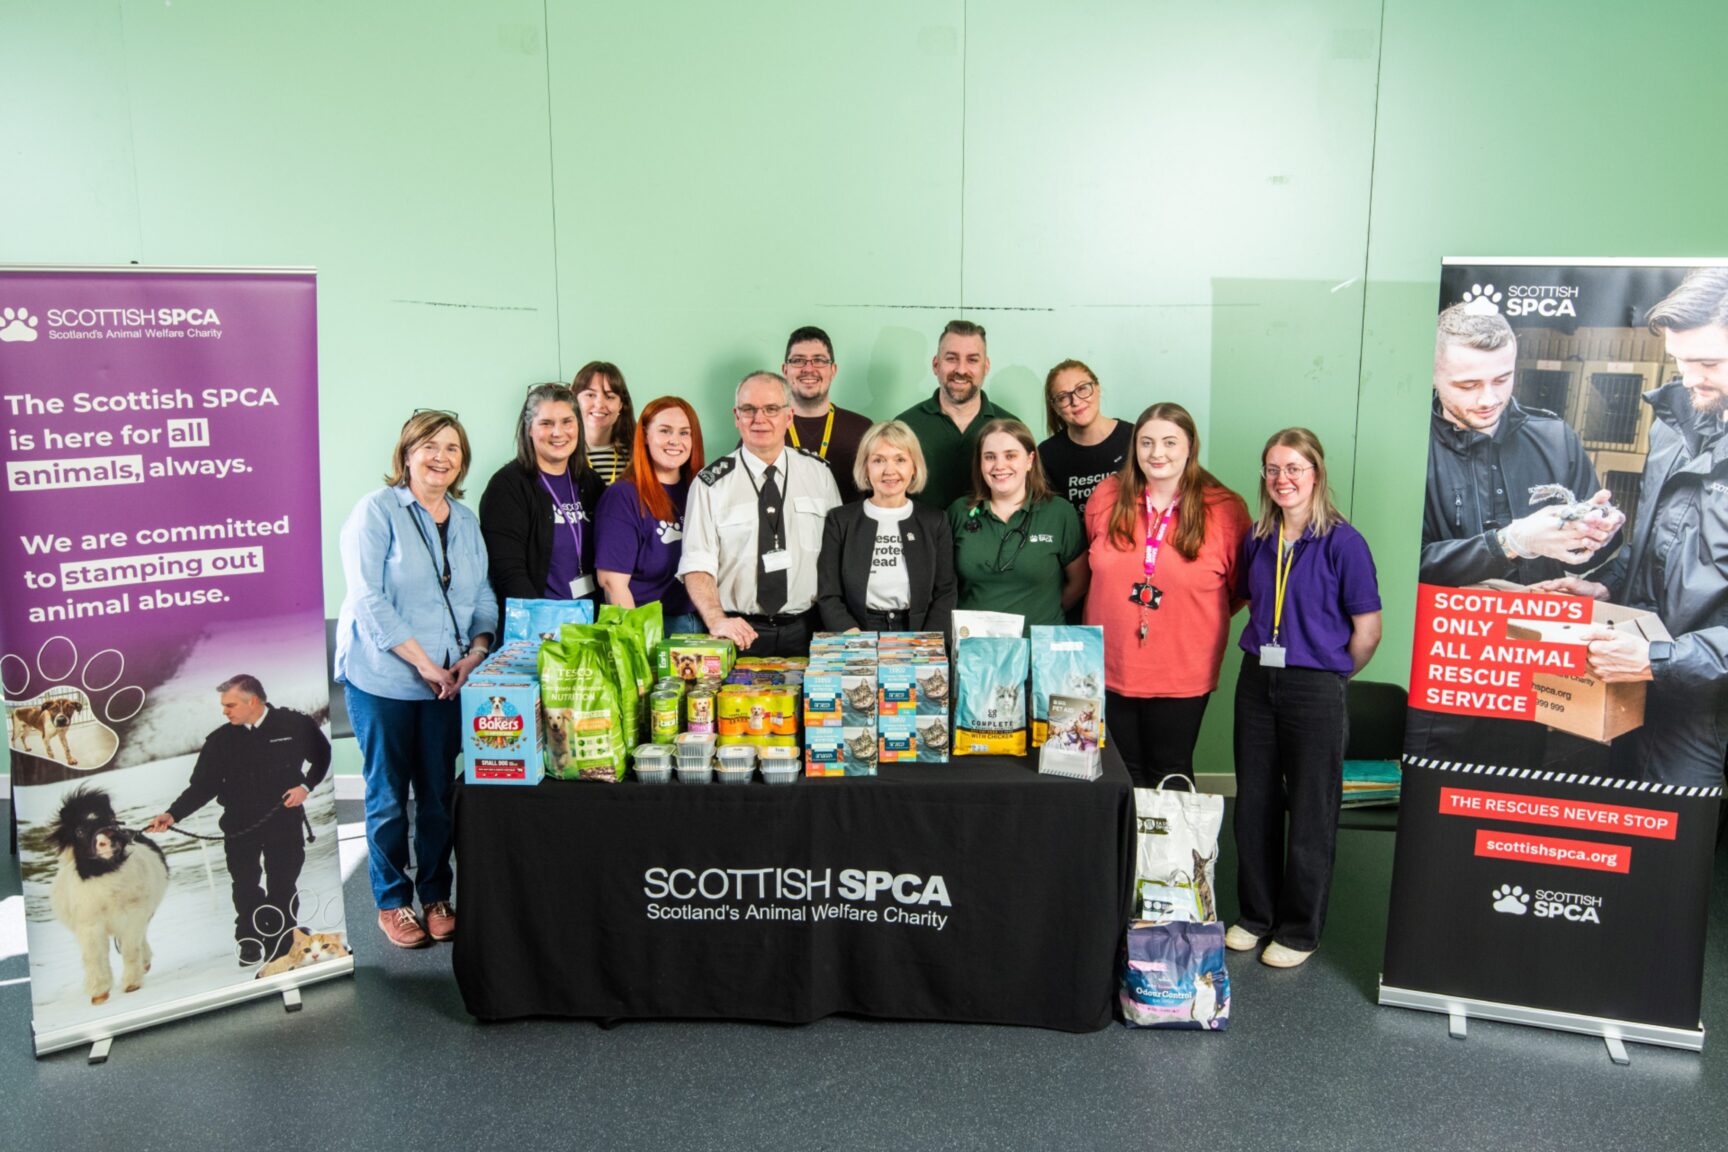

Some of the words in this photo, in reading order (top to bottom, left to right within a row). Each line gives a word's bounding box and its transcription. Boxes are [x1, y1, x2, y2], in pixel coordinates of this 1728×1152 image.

[1507, 285, 1579, 298] SCOTTISH
[47, 308, 155, 326] SCOTTISH
[158, 308, 221, 326] SPCA
[1506, 298, 1576, 317] SPCA
[48, 329, 103, 340] Scotland's
[106, 329, 142, 339] Animal
[145, 328, 185, 338] Welfare
[187, 328, 222, 340] Charity
[4, 394, 64, 415] The
[73, 388, 193, 413] Scottish
[202, 387, 280, 408] SPCA
[9, 429, 35, 451] is
[44, 428, 113, 449] here
[121, 425, 162, 445] for
[170, 421, 205, 443] all
[14, 459, 141, 486] animals,
[149, 457, 253, 478] always.
[20, 534, 72, 555] We
[81, 531, 128, 550] are
[136, 515, 290, 545] committed
[875, 535, 902, 544] escu
[872, 556, 897, 567] ead
[875, 545, 902, 555] rote
[24, 570, 56, 589] to
[65, 555, 203, 585] stamping
[211, 551, 258, 571] out
[28, 593, 130, 623] animal
[138, 588, 230, 610] abuse.
[1434, 592, 1584, 619] SCOTLAND’S
[1432, 616, 1493, 637] ONLY
[1430, 641, 1471, 660] ALL
[1479, 645, 1576, 668] ANIMAL
[558, 668, 593, 677] TESCO
[1428, 664, 1521, 688] RESCUE
[1426, 688, 1528, 713] SERVICE
[479, 716, 519, 730] Bakers
[1450, 794, 1481, 810] THE
[1485, 799, 1560, 818] RESCUES
[1563, 807, 1619, 825] NEVER
[1623, 813, 1669, 830] STOP
[1486, 838, 1618, 867] scottishspca.org
[643, 867, 832, 901] SCOTTISH
[838, 868, 952, 907] SPCA
[1535, 889, 1602, 907] SCOTTISH
[646, 903, 740, 921] Scotland's
[745, 904, 806, 921] Animal
[811, 903, 878, 923] Welfare
[883, 906, 949, 931] Charity
[1533, 900, 1600, 925] SPCA
